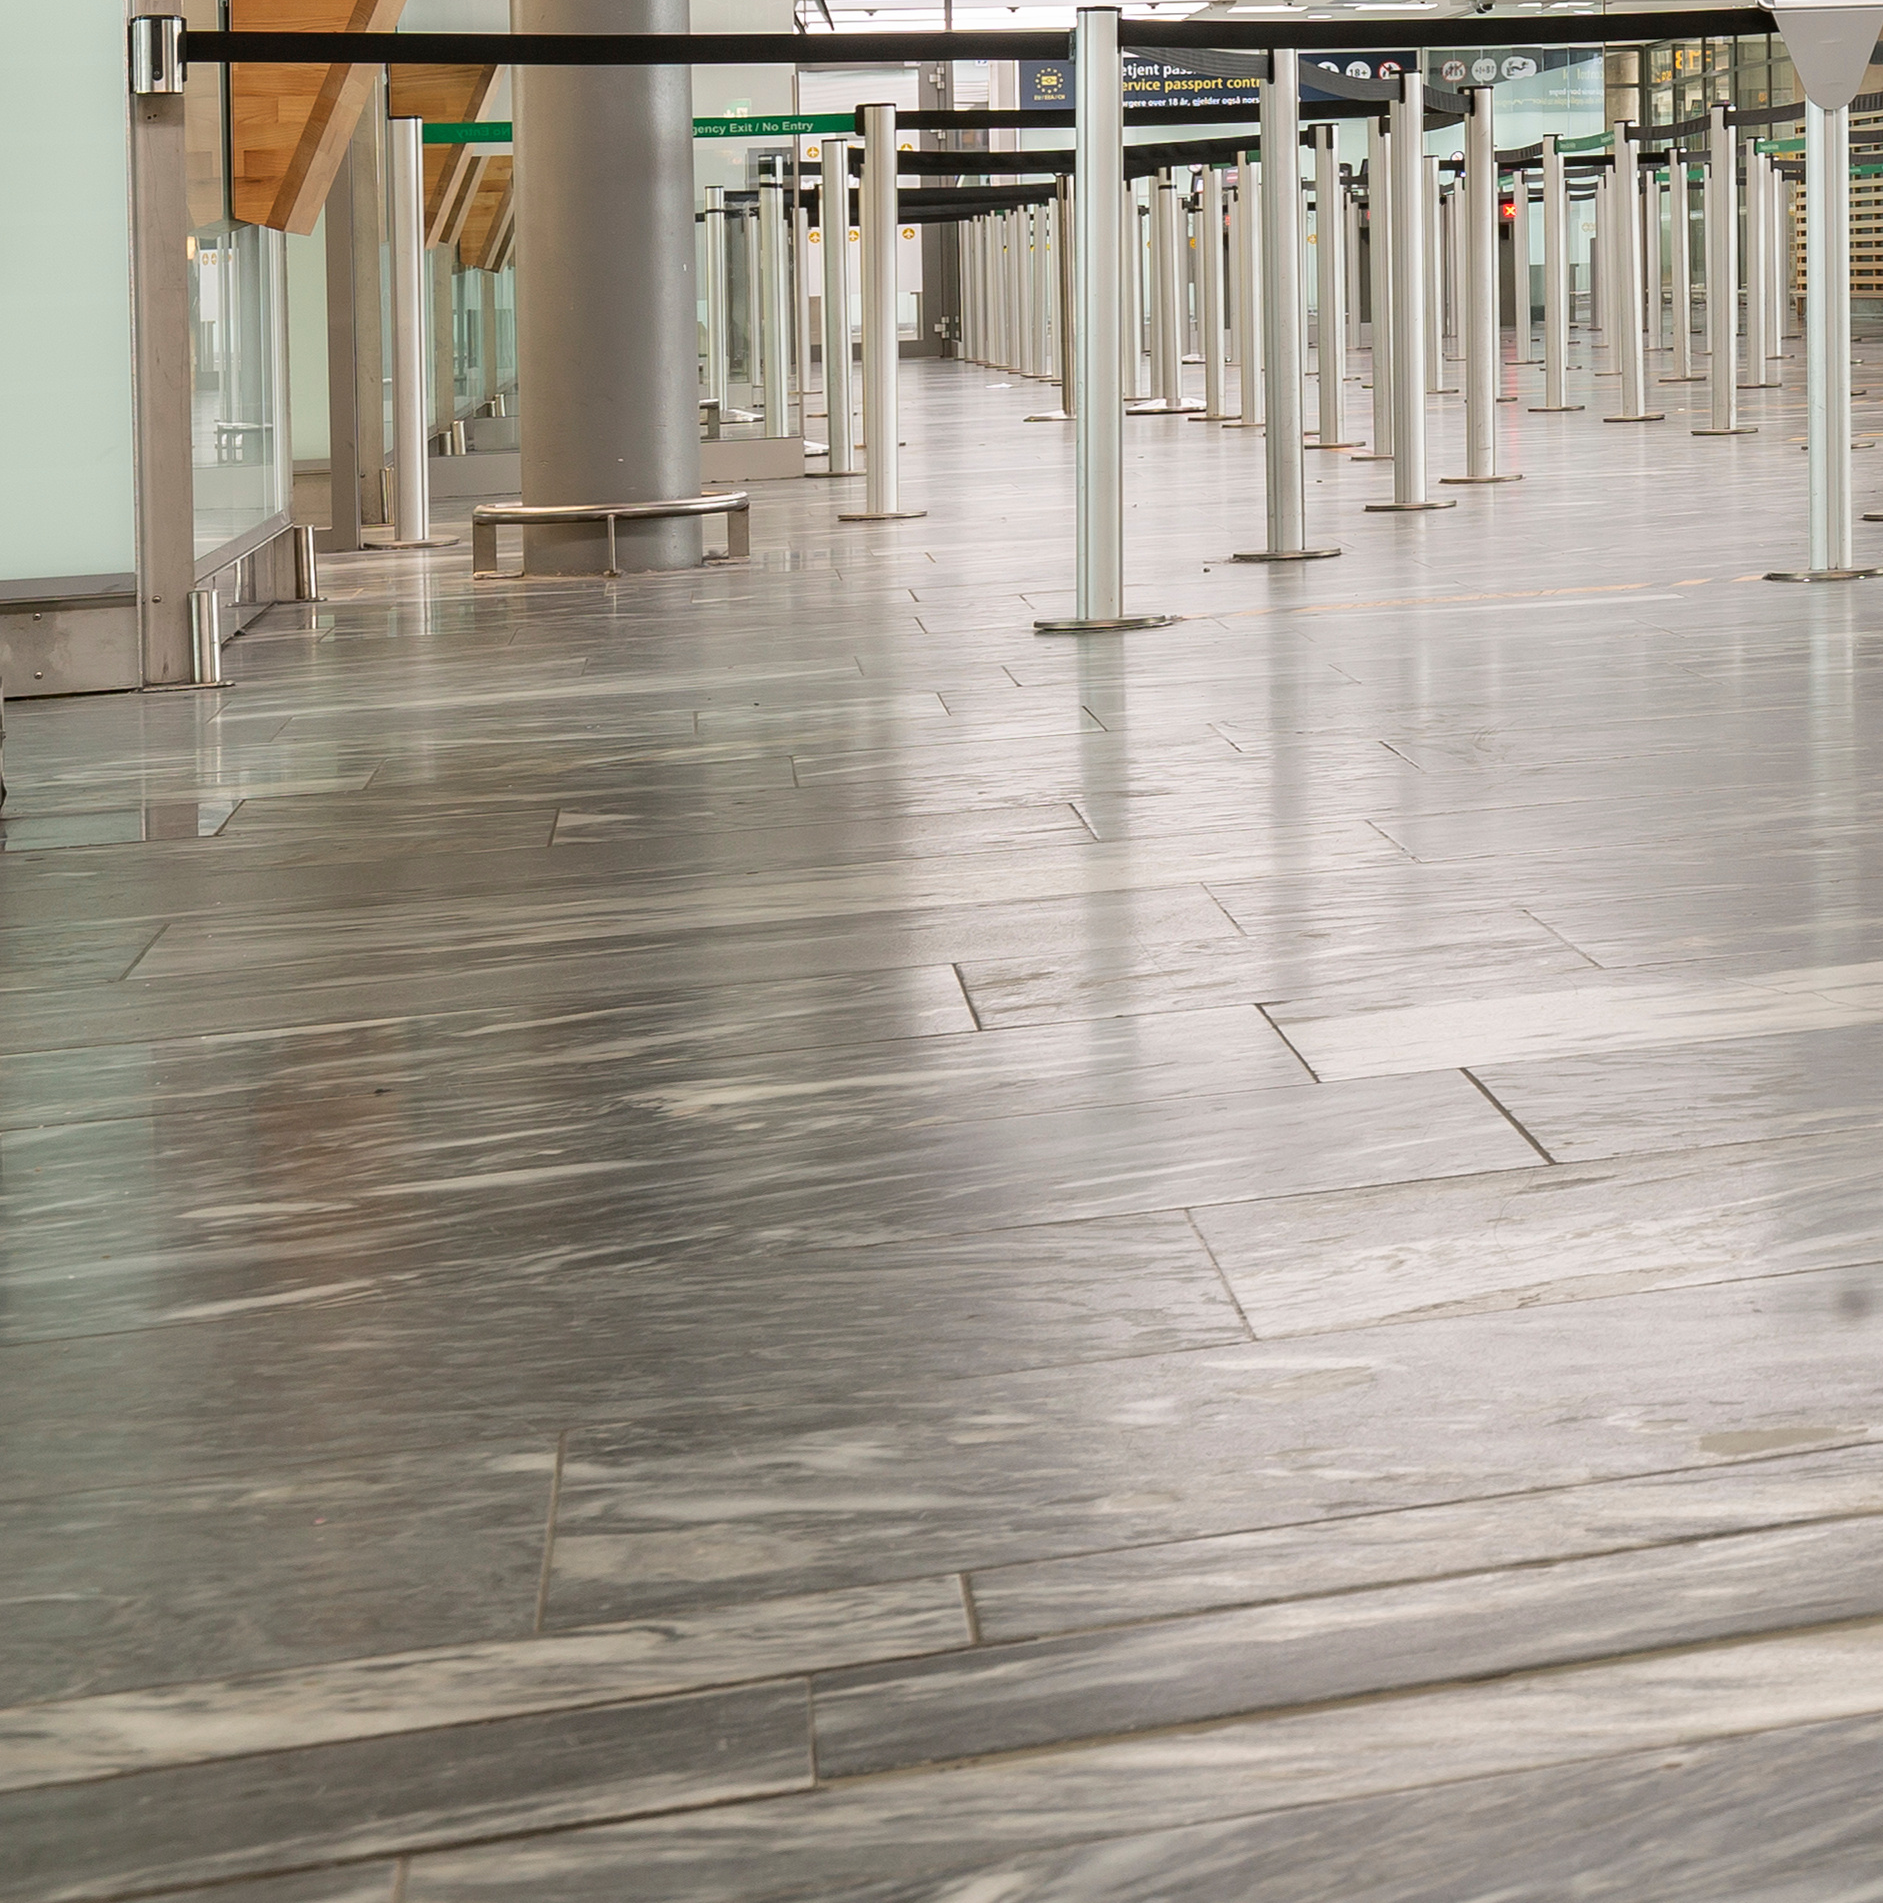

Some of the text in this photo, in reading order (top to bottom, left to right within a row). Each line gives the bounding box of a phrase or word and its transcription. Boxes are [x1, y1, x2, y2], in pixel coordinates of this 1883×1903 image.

[1164, 76, 1223, 94] passport
[1226, 77, 1260, 89] contr
[1147, 97, 1167, 108] over
[1168, 96, 1179, 107] 18
[1241, 95, 1260, 105] nors
[691, 120, 814, 136] gency Exit / No Entry
